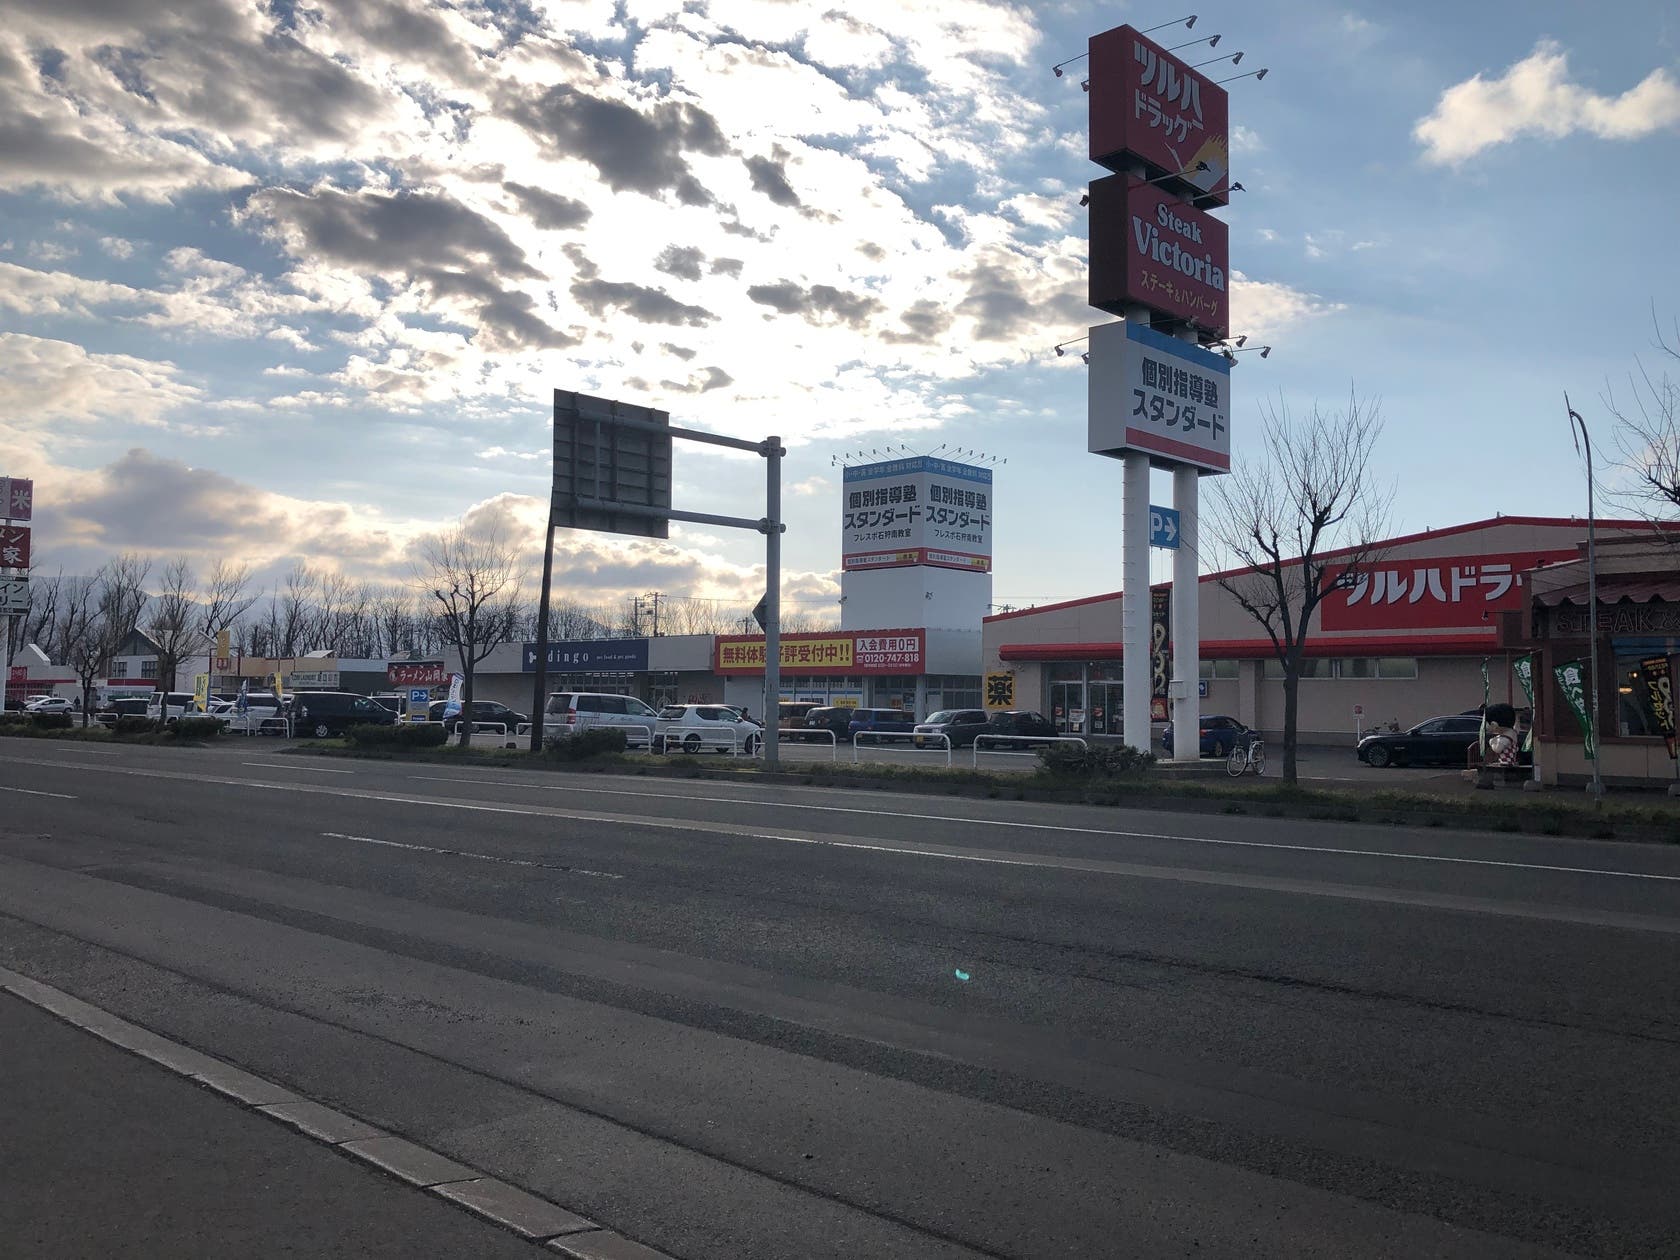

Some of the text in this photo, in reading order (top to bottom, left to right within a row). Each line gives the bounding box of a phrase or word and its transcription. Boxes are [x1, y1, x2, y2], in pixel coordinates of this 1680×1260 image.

[1133, 40, 1203, 122] ツルハ
[1156, 203, 1203, 245] Steak
[1132, 215, 1225, 292] Victoria
[1141, 356, 1219, 409] 個別指導塾
[1132, 387, 1225, 440] スタンダード
[11, 489, 31, 510] 米
[849, 484, 917, 509] 個別指導塾
[930, 484, 987, 511] 個別指導塾
[844, 505, 921, 530] スタンダード
[926, 505, 991, 531] スタンダード
[1150, 512, 1163, 541] P
[2, 546, 23, 564] 家
[547, 649, 589, 664] dingo
[411, 690, 420, 701] P
[987, 674, 1013, 706] 薬
